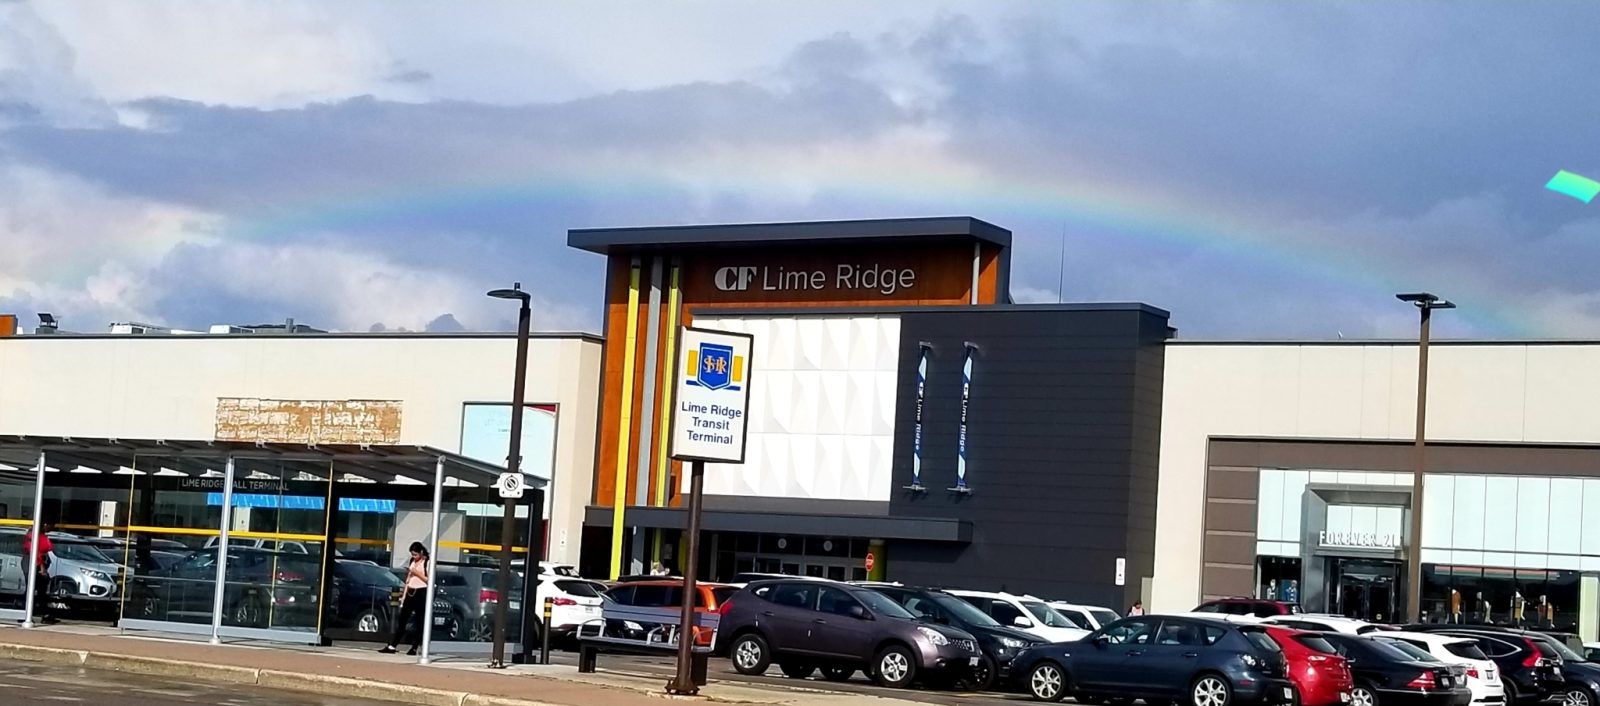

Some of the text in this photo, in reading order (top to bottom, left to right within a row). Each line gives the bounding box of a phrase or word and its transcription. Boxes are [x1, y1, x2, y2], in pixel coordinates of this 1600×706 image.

[714, 263, 915, 295] CF Lime Ridge
[681, 401, 742, 419] Lime Ridge
[692, 416, 730, 430] Transit
[687, 430, 733, 445] Terminal
[181, 478, 200, 487] LIME
[249, 481, 289, 491] TERMINAL
[1319, 530, 1395, 548] FOREVER 21
